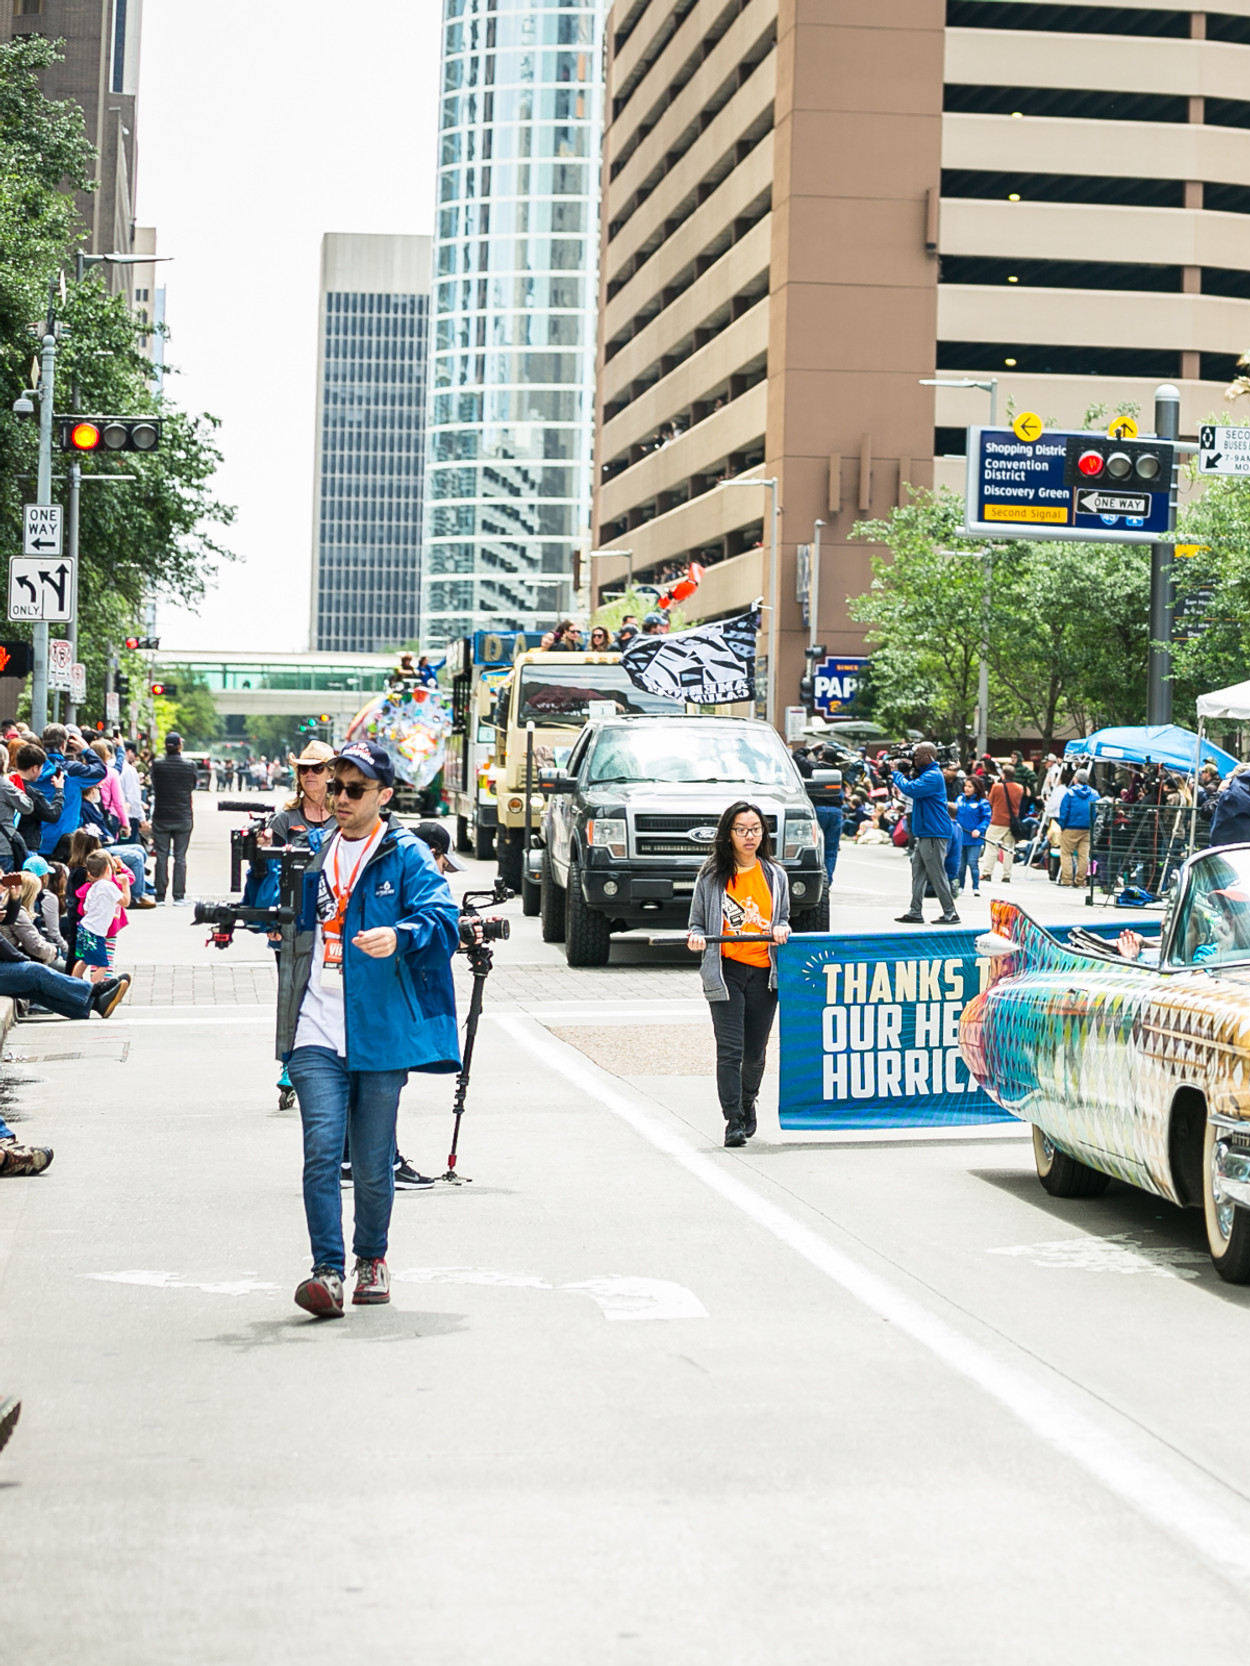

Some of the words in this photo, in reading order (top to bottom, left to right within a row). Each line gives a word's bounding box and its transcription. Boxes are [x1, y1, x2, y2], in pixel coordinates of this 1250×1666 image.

[985, 442, 1033, 457] Shopping
[1035, 444, 1067, 457] Distric
[1224, 441, 1247, 450] BUSES
[985, 458, 1049, 471] Convention
[984, 470, 1026, 481] District
[984, 485, 1035, 499] Discovery
[1038, 487, 1070, 499] Green
[1094, 498, 1116, 509] ONE
[1119, 499, 1142, 510] WAY
[30, 509, 57, 521] ONE
[991, 507, 1028, 518] Second
[1031, 509, 1061, 520] Signal
[29, 524, 57, 535] WAY
[13, 605, 41, 616] ONLY
[822, 958, 964, 1004] THANKS
[975, 957, 992, 994] T
[822, 1004, 903, 1053] OUR
[915, 1002, 963, 1048] HE
